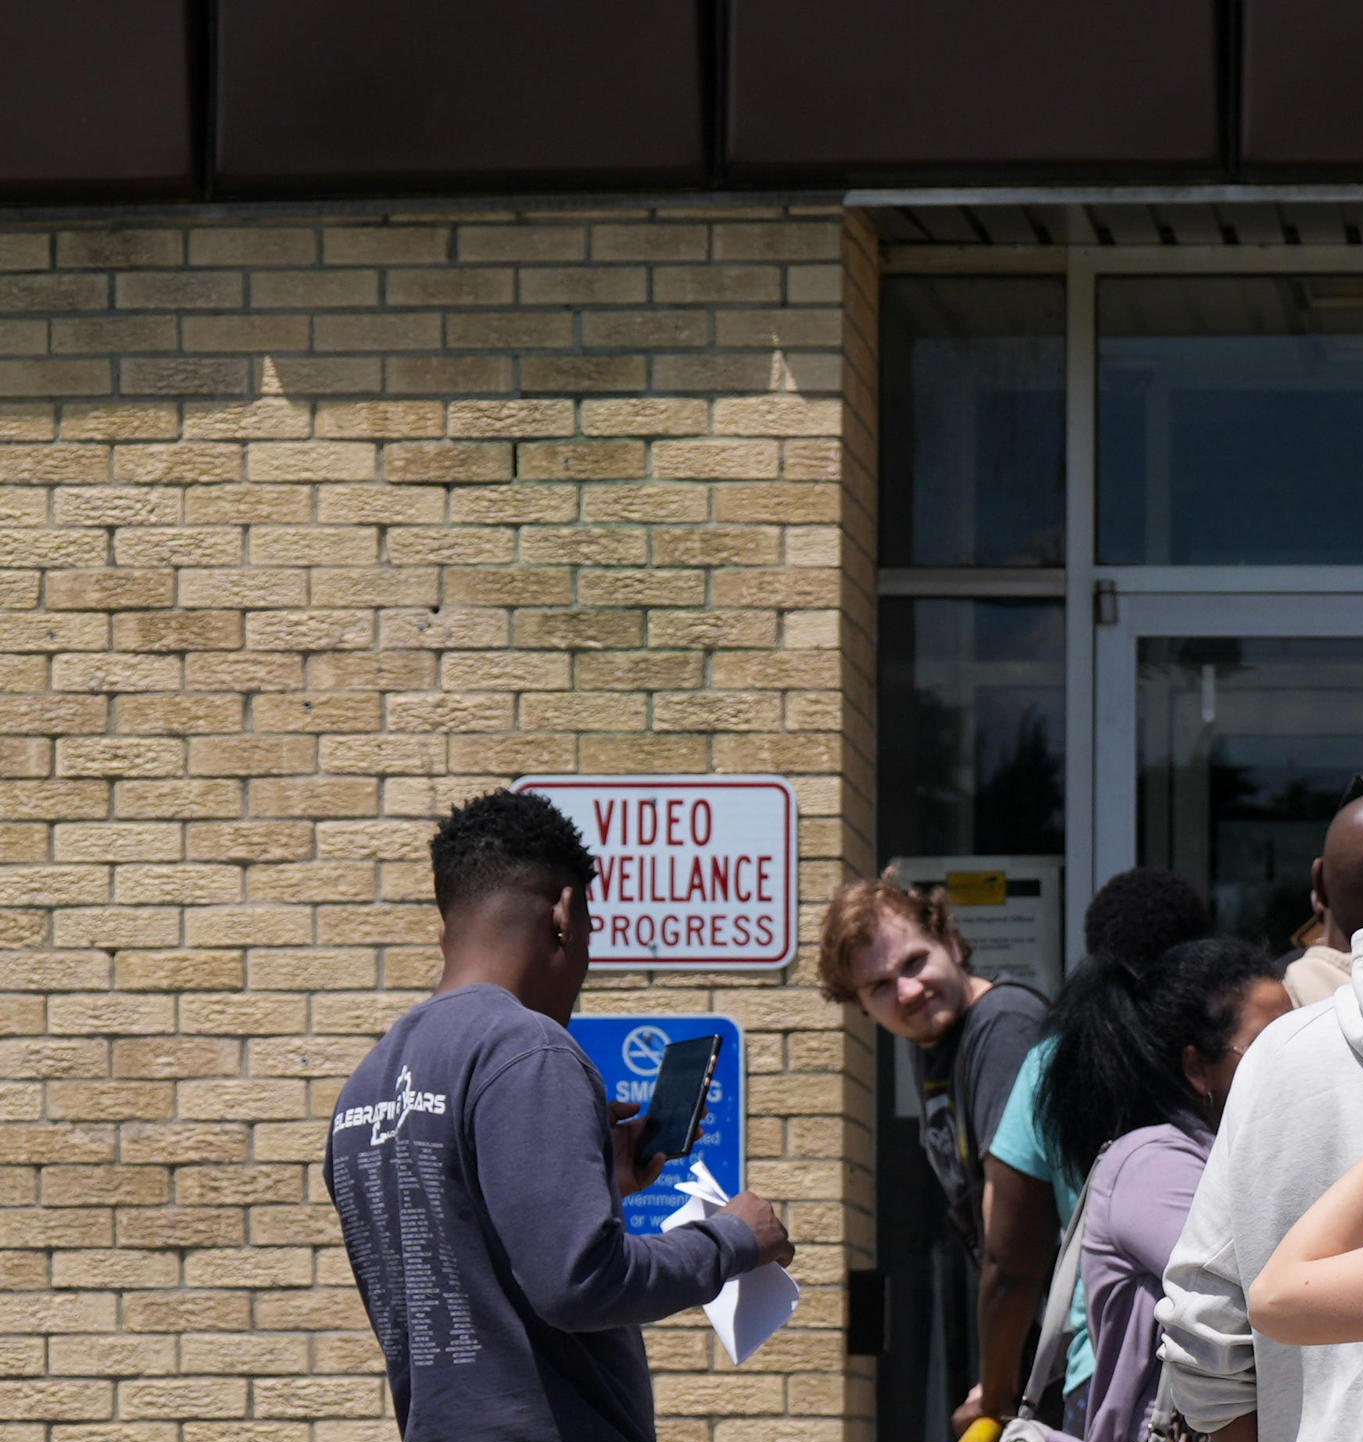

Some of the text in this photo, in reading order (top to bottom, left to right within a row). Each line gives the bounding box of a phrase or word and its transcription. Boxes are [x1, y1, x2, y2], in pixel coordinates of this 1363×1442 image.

[594, 800, 712, 846] VIDEO
[585, 856, 773, 902] VEILLANCE
[588, 915, 774, 946] PROGRESS
[402, 1091, 446, 1115] YEARS
[622, 1194, 689, 1207] vernment
